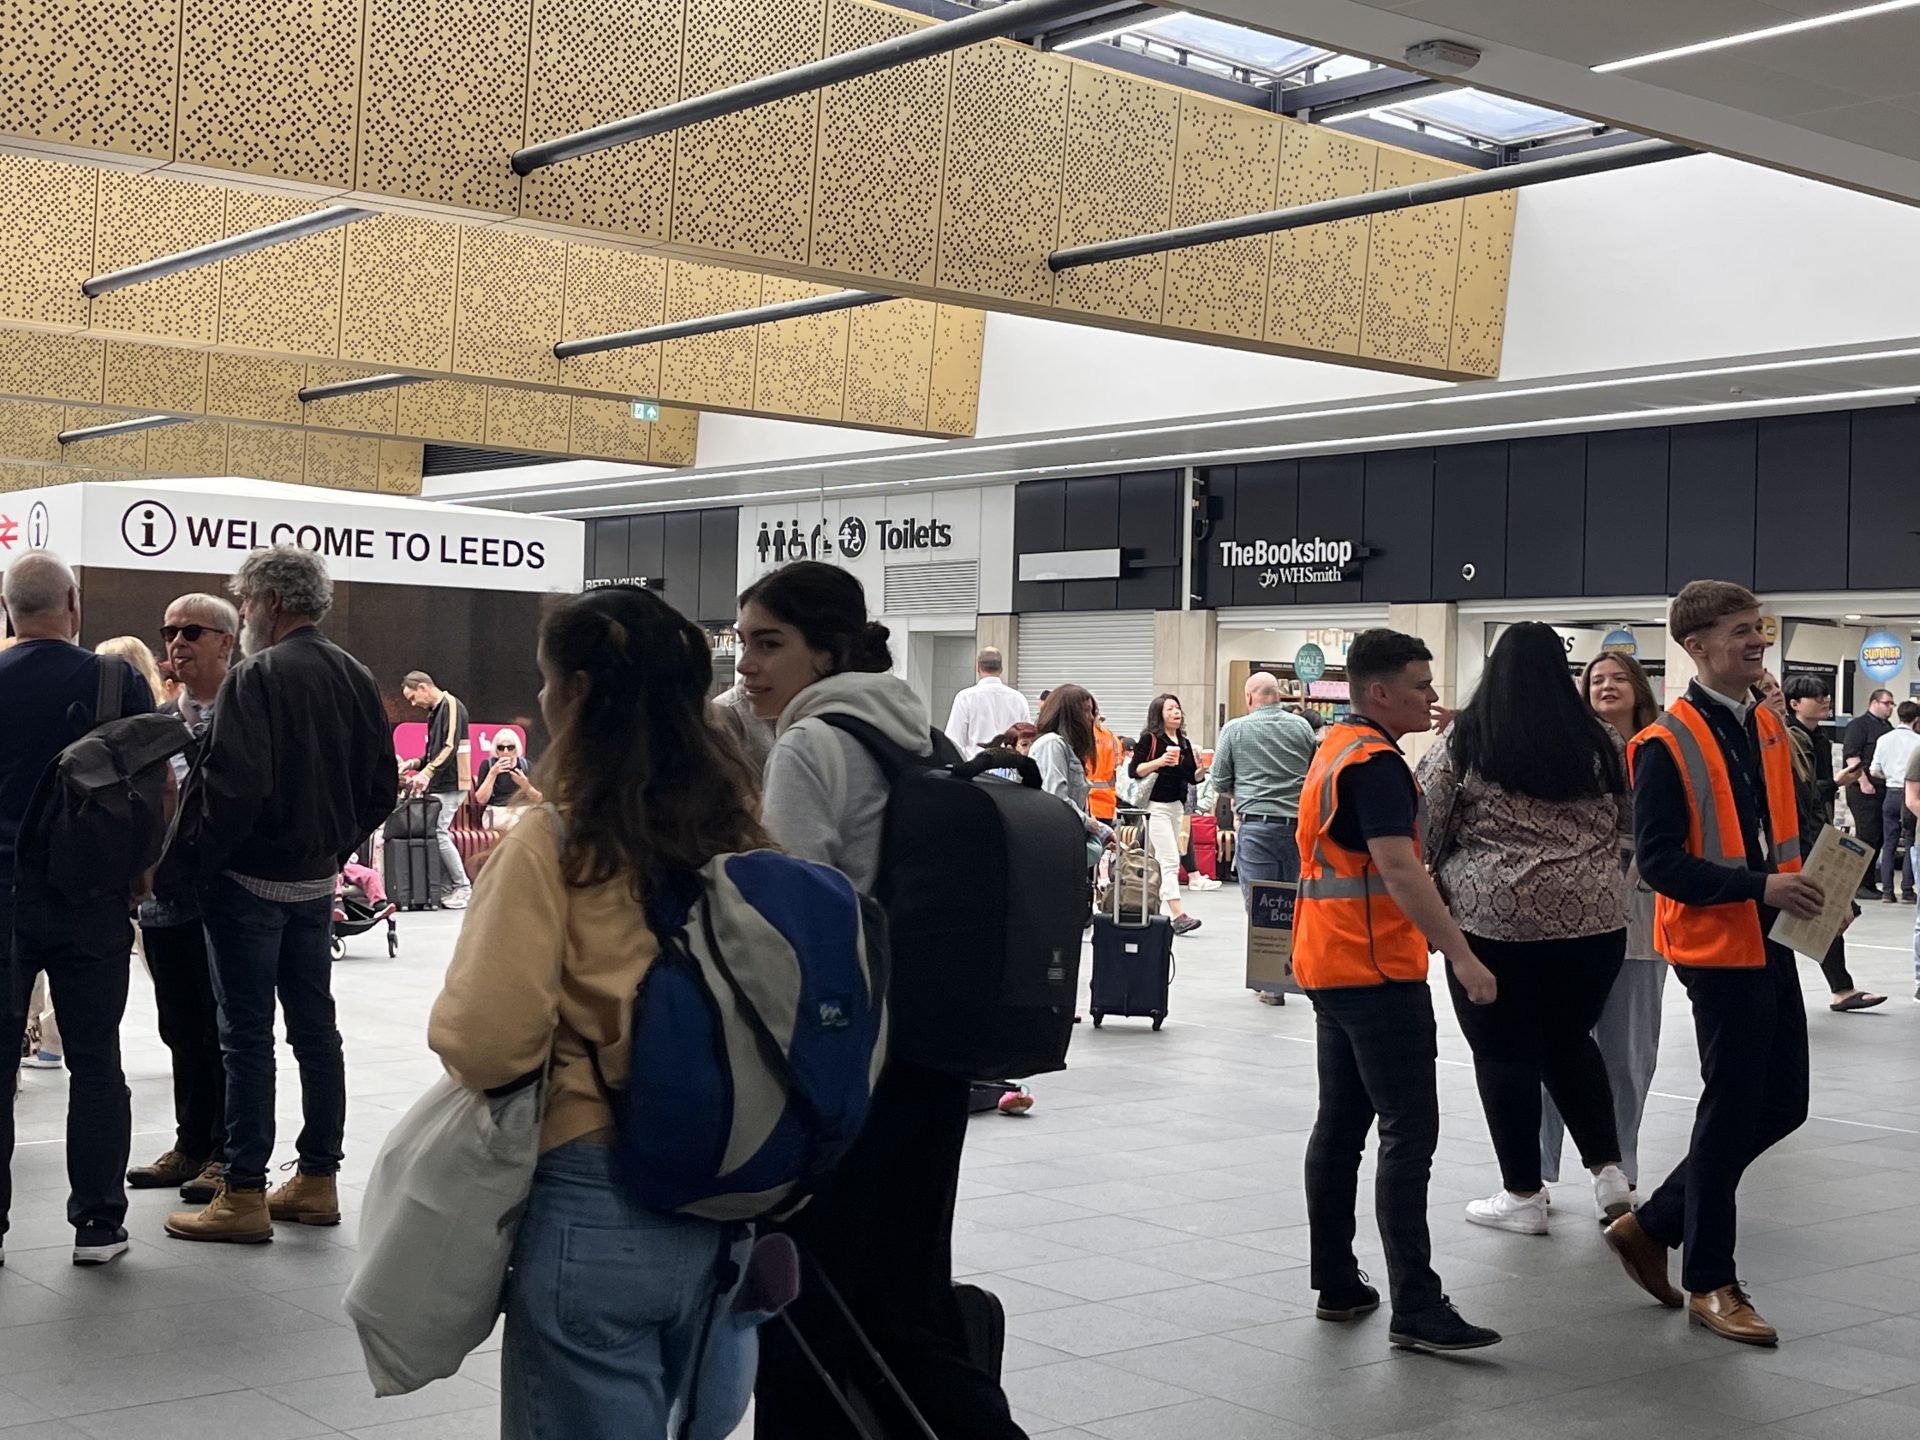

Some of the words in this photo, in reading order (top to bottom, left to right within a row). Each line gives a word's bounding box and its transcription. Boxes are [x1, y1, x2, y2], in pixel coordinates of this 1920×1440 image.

[186, 516, 375, 559] WELCOME
[385, 531, 430, 562] TO
[440, 535, 545, 569] LEEDS
[875, 517, 952, 551] Toilets
[1279, 566, 1342, 583] WHSmith
[1298, 655, 1322, 666] HALF
